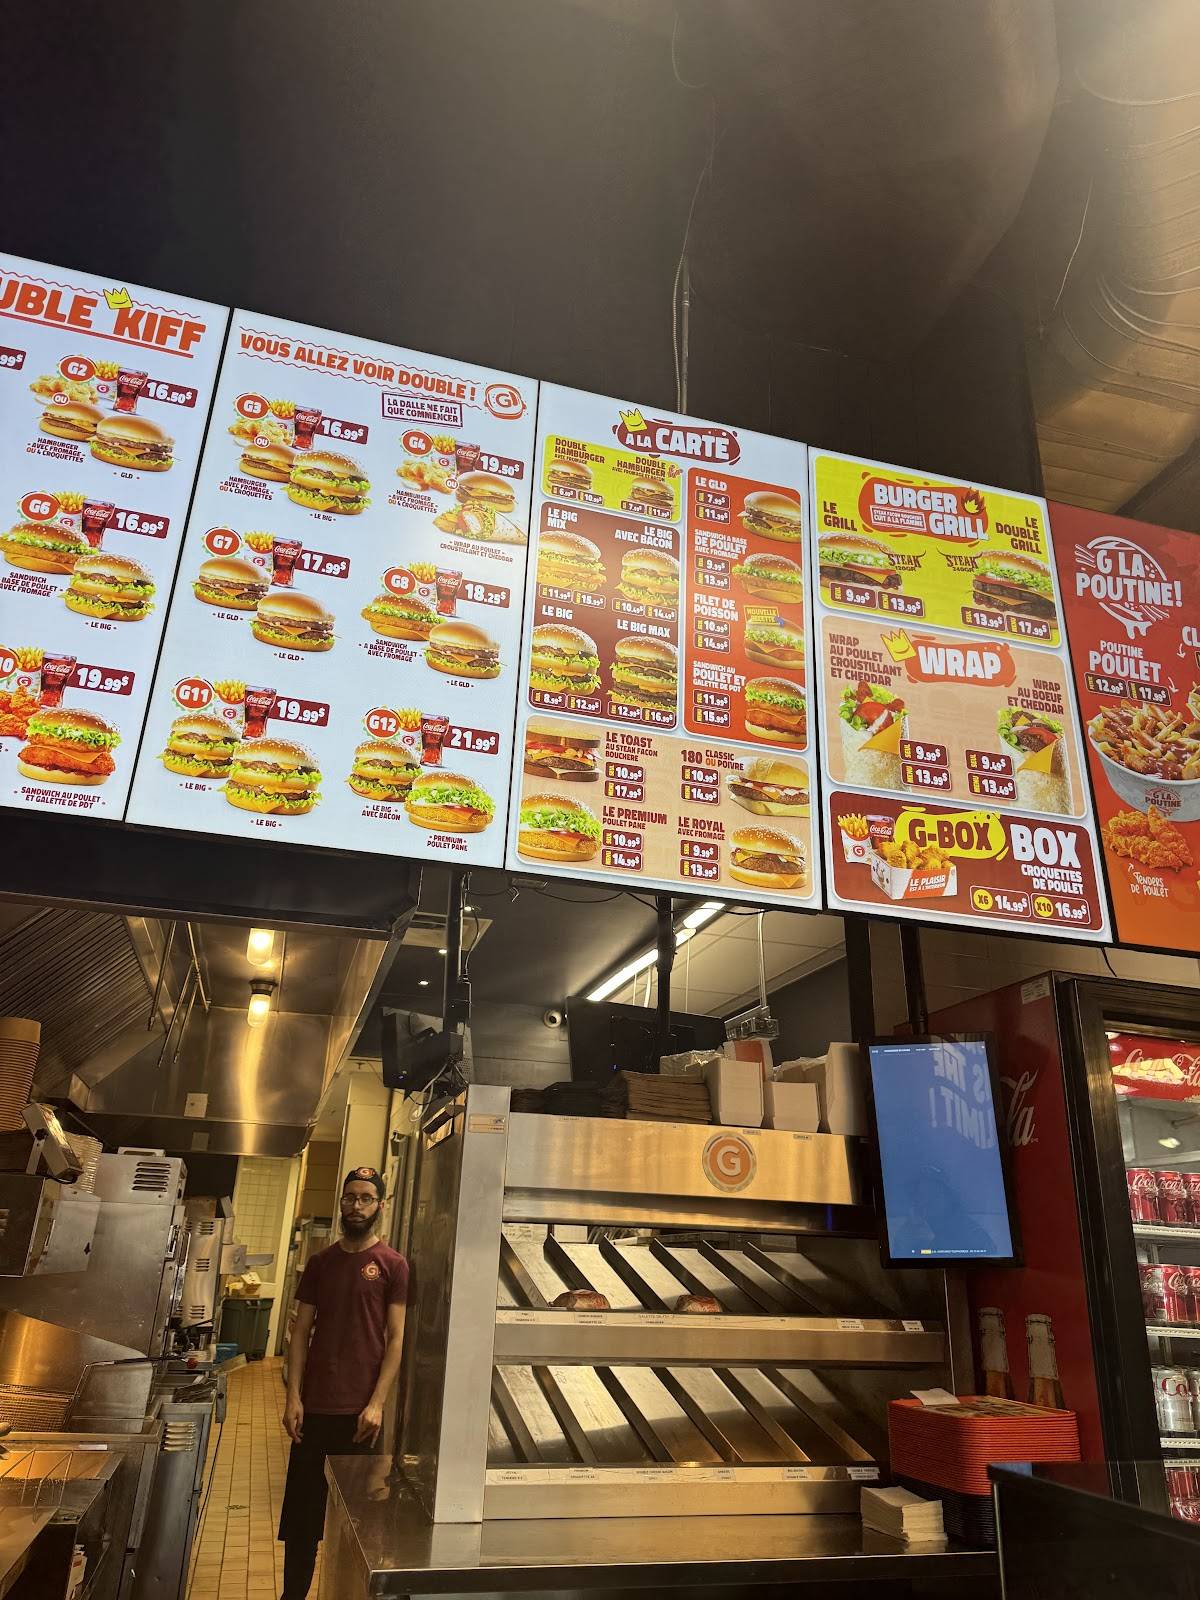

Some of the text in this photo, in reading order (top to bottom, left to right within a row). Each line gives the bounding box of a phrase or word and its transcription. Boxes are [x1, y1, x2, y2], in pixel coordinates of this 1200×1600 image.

[114, 309, 206, 350] KIFF
[68, 362, 87, 376] G2
[240, 334, 475, 400] VOUS ALLEZ VOIR DOUBLE !
[54, 395, 68, 404] OU
[147, 382, 192, 402] 16.50$
[244, 400, 261, 413] G3
[388, 398, 398, 407] LA
[400, 400, 425, 410] DALLE
[440, 405, 458, 414] FAIT
[407, 409, 459, 423] COMMENCER
[322, 420, 363, 440] 16.99$
[38, 438, 79, 450] HAMBURGER
[409, 436, 425, 450] G4
[555, 438, 587, 451] DOUBLE
[637, 435, 652, 448] LA
[656, 428, 730, 460] CARTE
[555, 446, 605, 463] HAMBURGER
[481, 457, 519, 476] 19.50$
[617, 460, 666, 477] HAMBURGER
[635, 457, 666, 469] DOUBLE
[224, 481, 270, 494] AVEC FROMAGE
[229, 476, 267, 488] HAMBURGER
[29, 500, 50, 514] G6
[823, 501, 837, 513] LE
[874, 484, 958, 514] BURGER
[116, 512, 163, 534] 16.99$
[548, 508, 577, 522] LE BIG
[1025, 517, 1038, 529] LE
[824, 517, 857, 531] GRILL
[929, 513, 989, 540] GRILL
[995, 522, 1040, 542] DOUBLE
[615, 530, 672, 549] AVEC BACON
[645, 526, 672, 539] LE BIG
[213, 535, 232, 549] G7
[695, 537, 747, 554] DE POULET
[1010, 537, 1042, 554] GRILL
[301, 552, 346, 575] 17.99$
[888, 554, 921, 568] STEAK
[946, 555, 979, 569] STEAK
[1097, 550, 1145, 577] G LA
[10, 572, 46, 584] SANDWICH
[391, 574, 409, 589] G8
[465, 583, 506, 604] 18.25$
[846, 589, 870, 603] 9.99$
[1076, 573, 1183, 607] POUTINE!
[694, 593, 735, 609] FILET DE
[891, 598, 920, 613] 13.99$
[542, 605, 573, 619] LE BIG
[694, 604, 738, 621] POISSON
[617, 619, 670, 638] LE BIG MAX
[973, 613, 1003, 628] 13.99$
[1018, 621, 1047, 636] 17.99$
[376, 639, 407, 649] SANDWICH
[830, 634, 859, 646] WRAP
[368, 650, 412, 662] AVEC FROMAGE
[830, 645, 883, 662] AU POULET
[1100, 640, 1144, 658] POUTINE
[830, 656, 902, 676] CROUSTILLANT
[918, 646, 1000, 679] WRAP
[1089, 651, 1161, 683] POULET
[77, 668, 129, 691] 19.99$
[693, 668, 746, 686] POULET ET
[831, 667, 891, 686] ET CHEDDAR
[179, 685, 209, 702] G11
[1033, 679, 1060, 692] WRAP
[1096, 678, 1123, 694] 12.99$
[1018, 687, 1062, 703] AU BOEUF
[1139, 687, 1166, 701] 17.99$
[278, 700, 325, 722] 19.99$
[1007, 696, 1064, 715] ET CHEDDAR
[369, 715, 396, 731] G12
[451, 729, 496, 750] 21.99$
[606, 732, 652, 748] LE TOAST
[681, 750, 702, 764] 180
[706, 750, 734, 761] CLASSIC
[916, 745, 940, 761] 9.99$
[706, 758, 744, 770] OU POIVRE
[982, 756, 1006, 770] 9.49$
[915, 769, 948, 787] 13.99$
[21, 787, 60, 798] SANDWICH
[73, 793, 100, 803] POULET
[981, 779, 1014, 795] 13.49$
[1145, 797, 1181, 807] POUTINE
[1161, 792, 1171, 800] LA
[362, 810, 401, 821] AVEC BACON
[603, 806, 667, 824] LE PREMIUM
[679, 816, 725, 832] LE ROYAL
[433, 835, 463, 844] PREMIUM
[678, 828, 725, 840] AVEC FROMAGE
[909, 818, 992, 851] G-BOX
[1010, 824, 1081, 869] BOX
[921, 876, 946, 886] PLAISIR
[1021, 864, 1082, 883] CROQUETTES
[1032, 878, 1084, 895] DE POULET
[977, 895, 1027, 912] X6 14.99$
[1035, 901, 1087, 919] X10 16.99$
[715, 1145, 741, 1176] G
